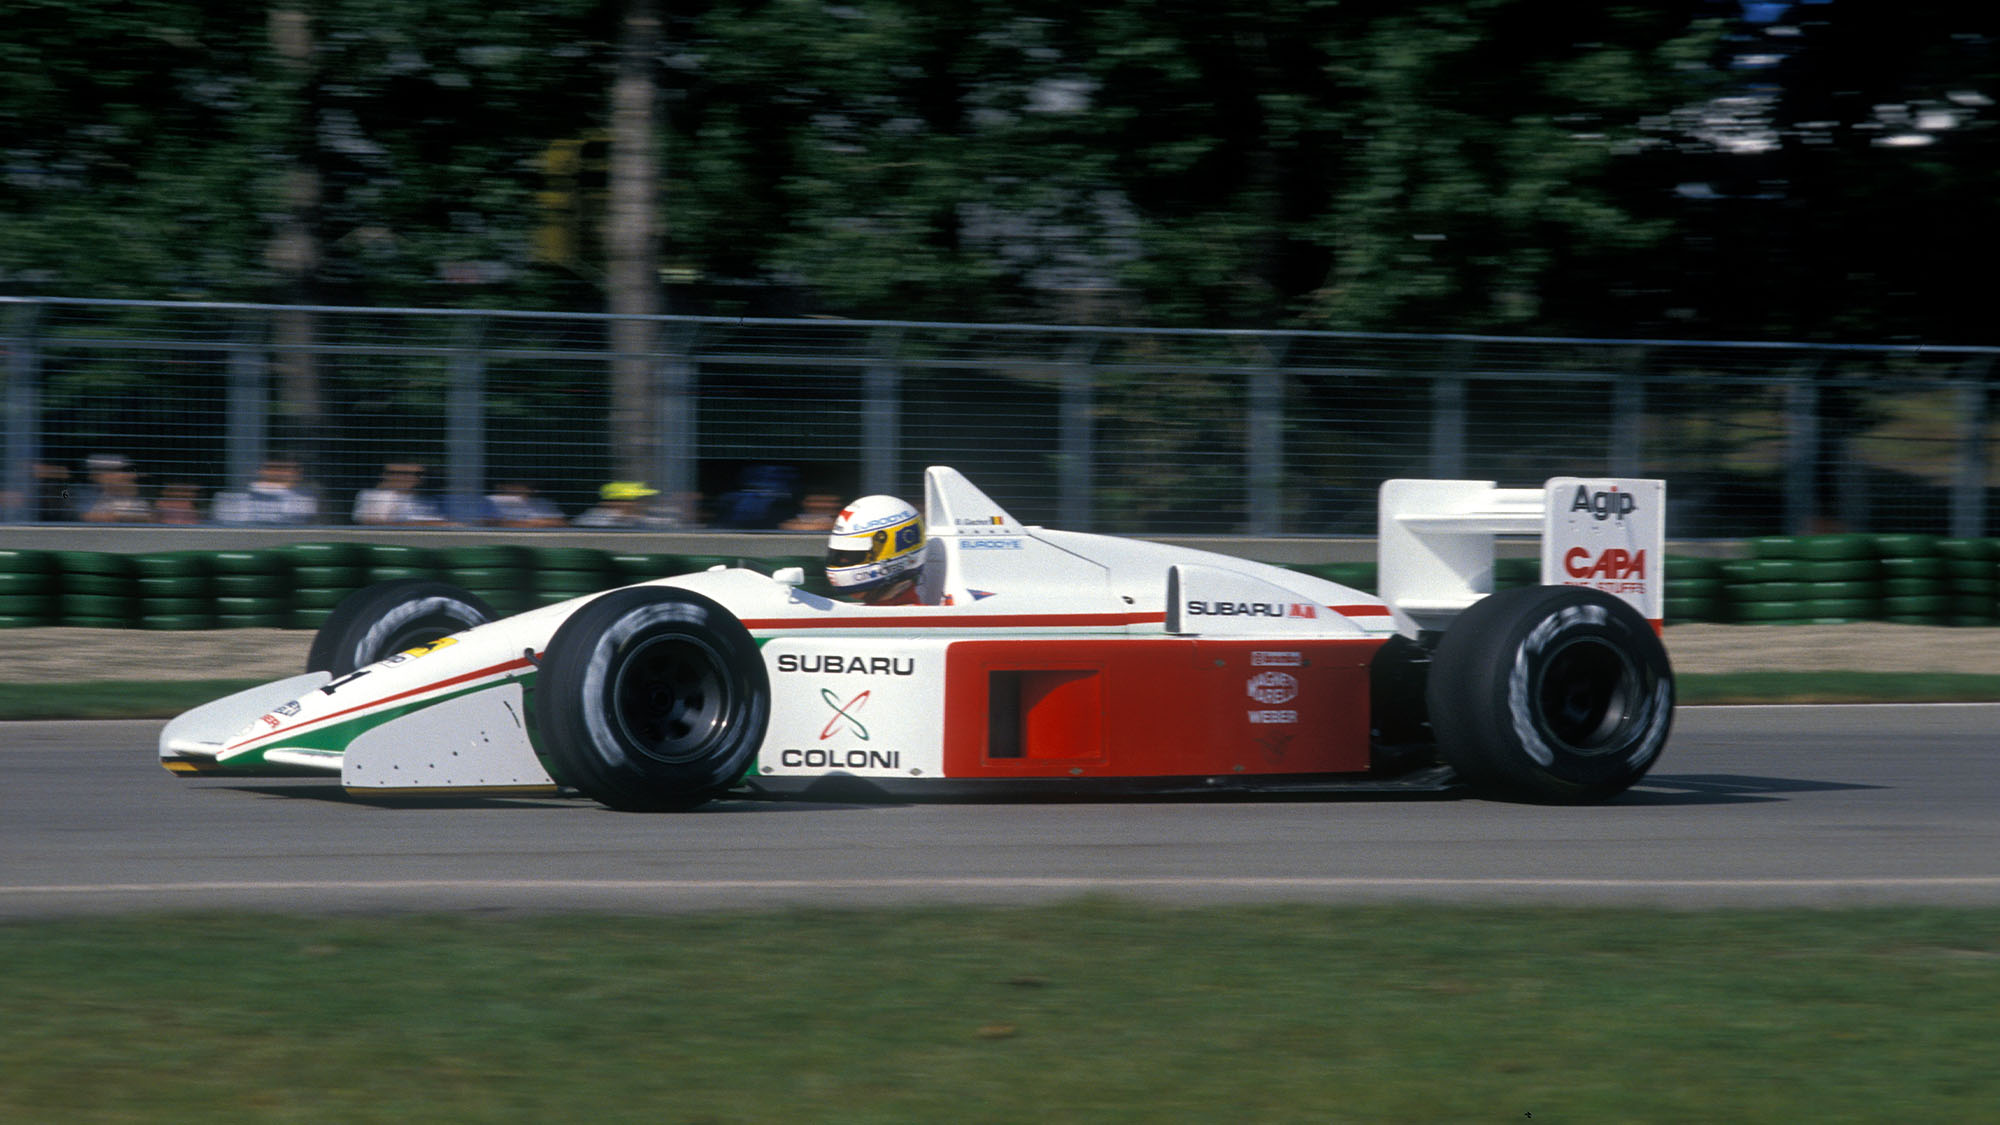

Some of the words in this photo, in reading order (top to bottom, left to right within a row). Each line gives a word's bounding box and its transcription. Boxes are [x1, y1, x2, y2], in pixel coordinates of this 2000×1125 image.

[1570, 484, 1637, 521] Agip
[1564, 546, 1647, 580] CAPA
[1188, 601, 1284, 617] SUBARU
[778, 654, 915, 676] SUBARU
[1247, 710, 1299, 723] WEBER
[782, 749, 900, 769] COLONI
